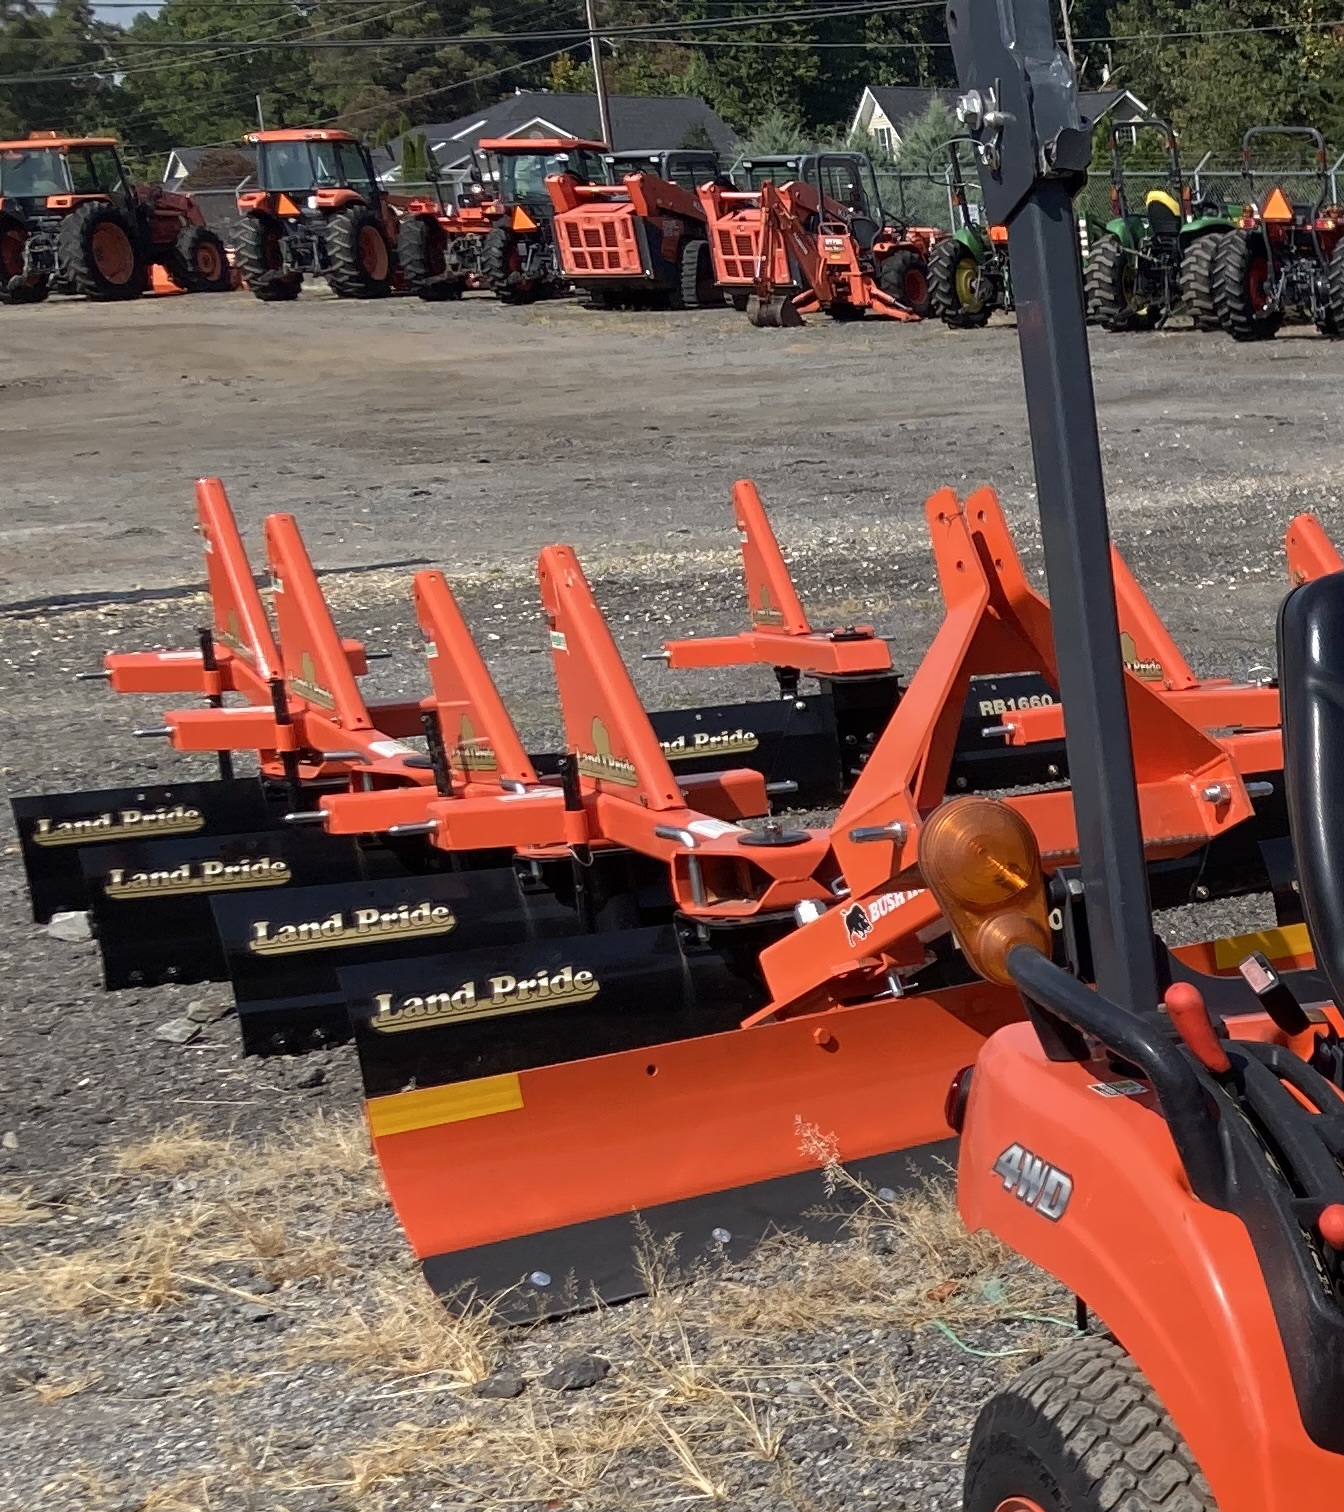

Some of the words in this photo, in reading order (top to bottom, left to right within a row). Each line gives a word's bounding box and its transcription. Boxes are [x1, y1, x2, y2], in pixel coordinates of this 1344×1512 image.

[978, 693, 1053, 717] RB1660
[658, 733, 686, 753] nd
[693, 728, 756, 751] Pride
[36, 813, 112, 836] Land
[120, 804, 202, 830] Pride
[108, 864, 191, 890] Land
[200, 857, 289, 883] Pride
[252, 912, 344, 946] Land
[355, 902, 452, 933] Pride
[375, 981, 478, 1022] Land
[490, 964, 597, 1004] Pride
[992, 1141, 1075, 1223] 4WD
